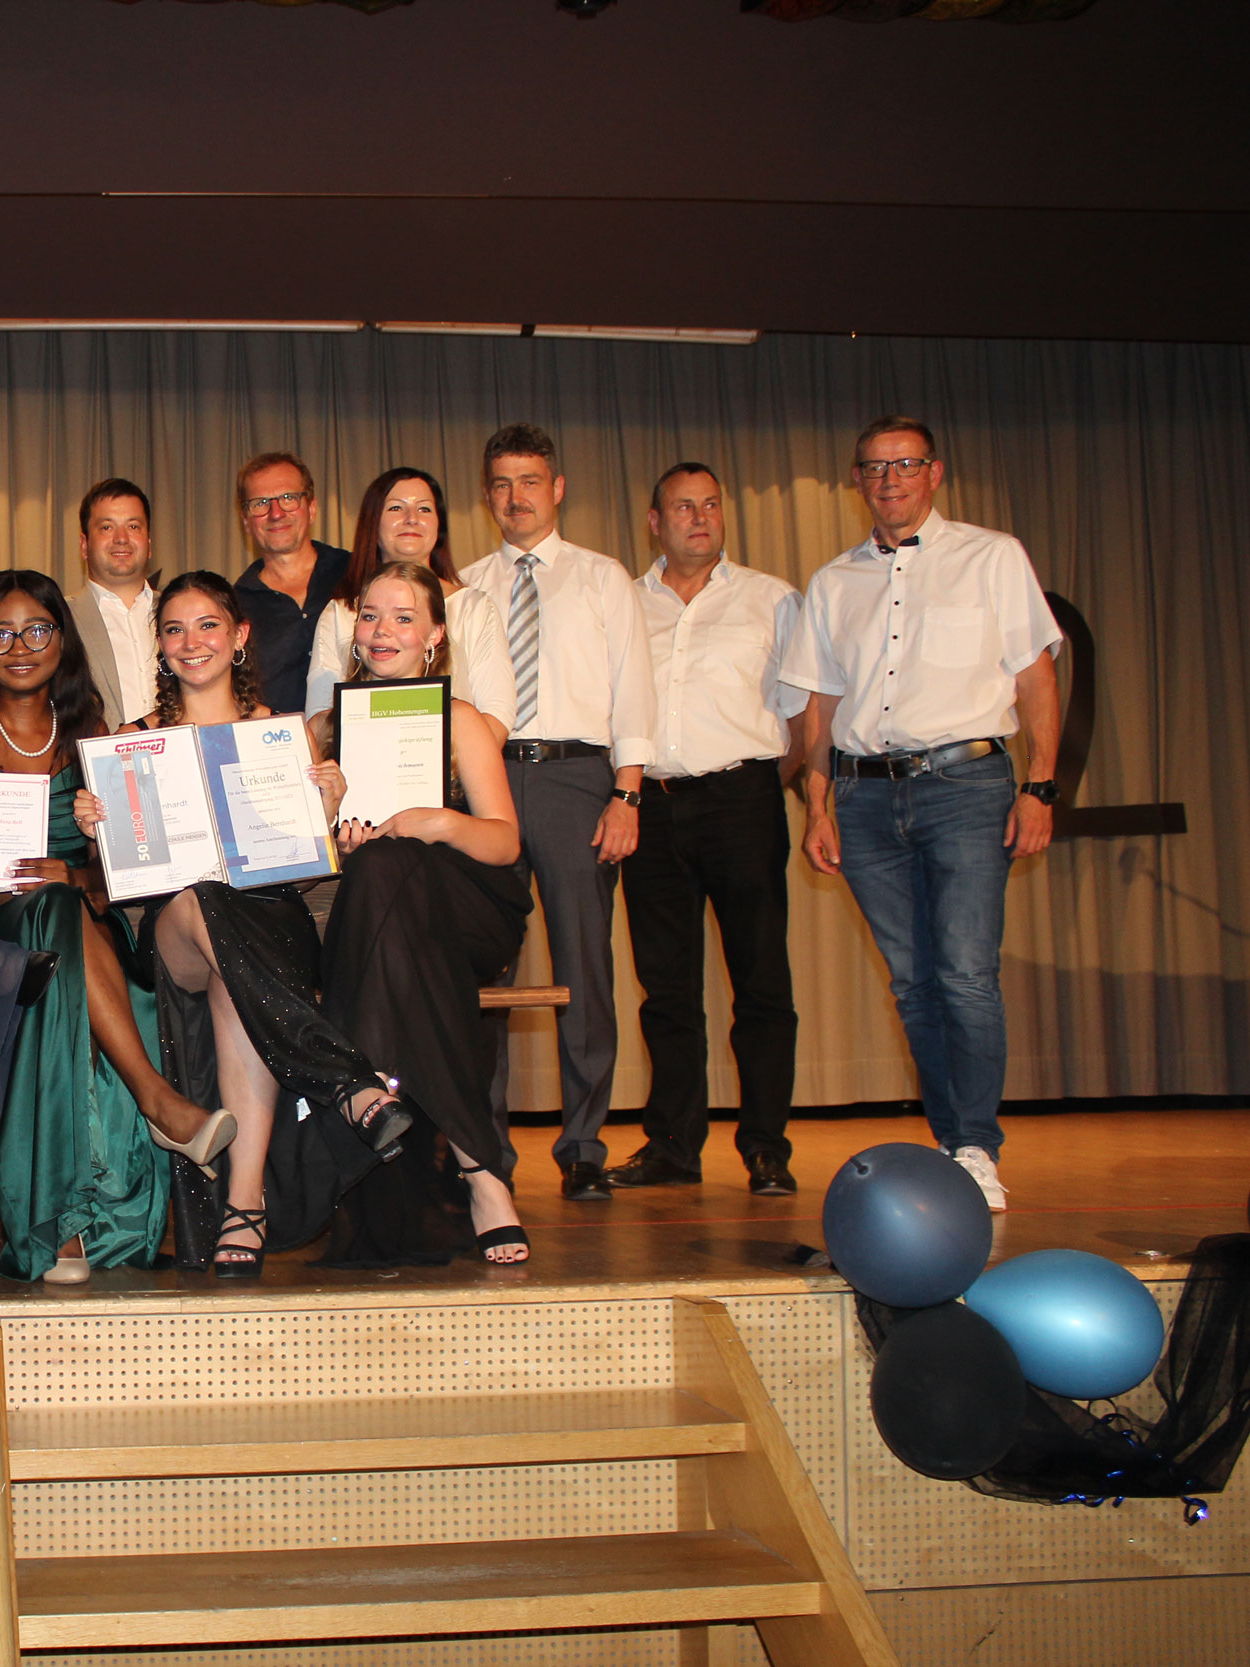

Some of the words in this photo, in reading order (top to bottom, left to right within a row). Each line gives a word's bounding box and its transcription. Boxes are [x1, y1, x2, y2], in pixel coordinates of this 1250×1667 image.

[389, 708, 429, 717] Hohentengen
[262, 729, 292, 745] OWB
[239, 772, 286, 787] Urkunde
[131, 811, 148, 844] EURO
[137, 844, 150, 862] 50
